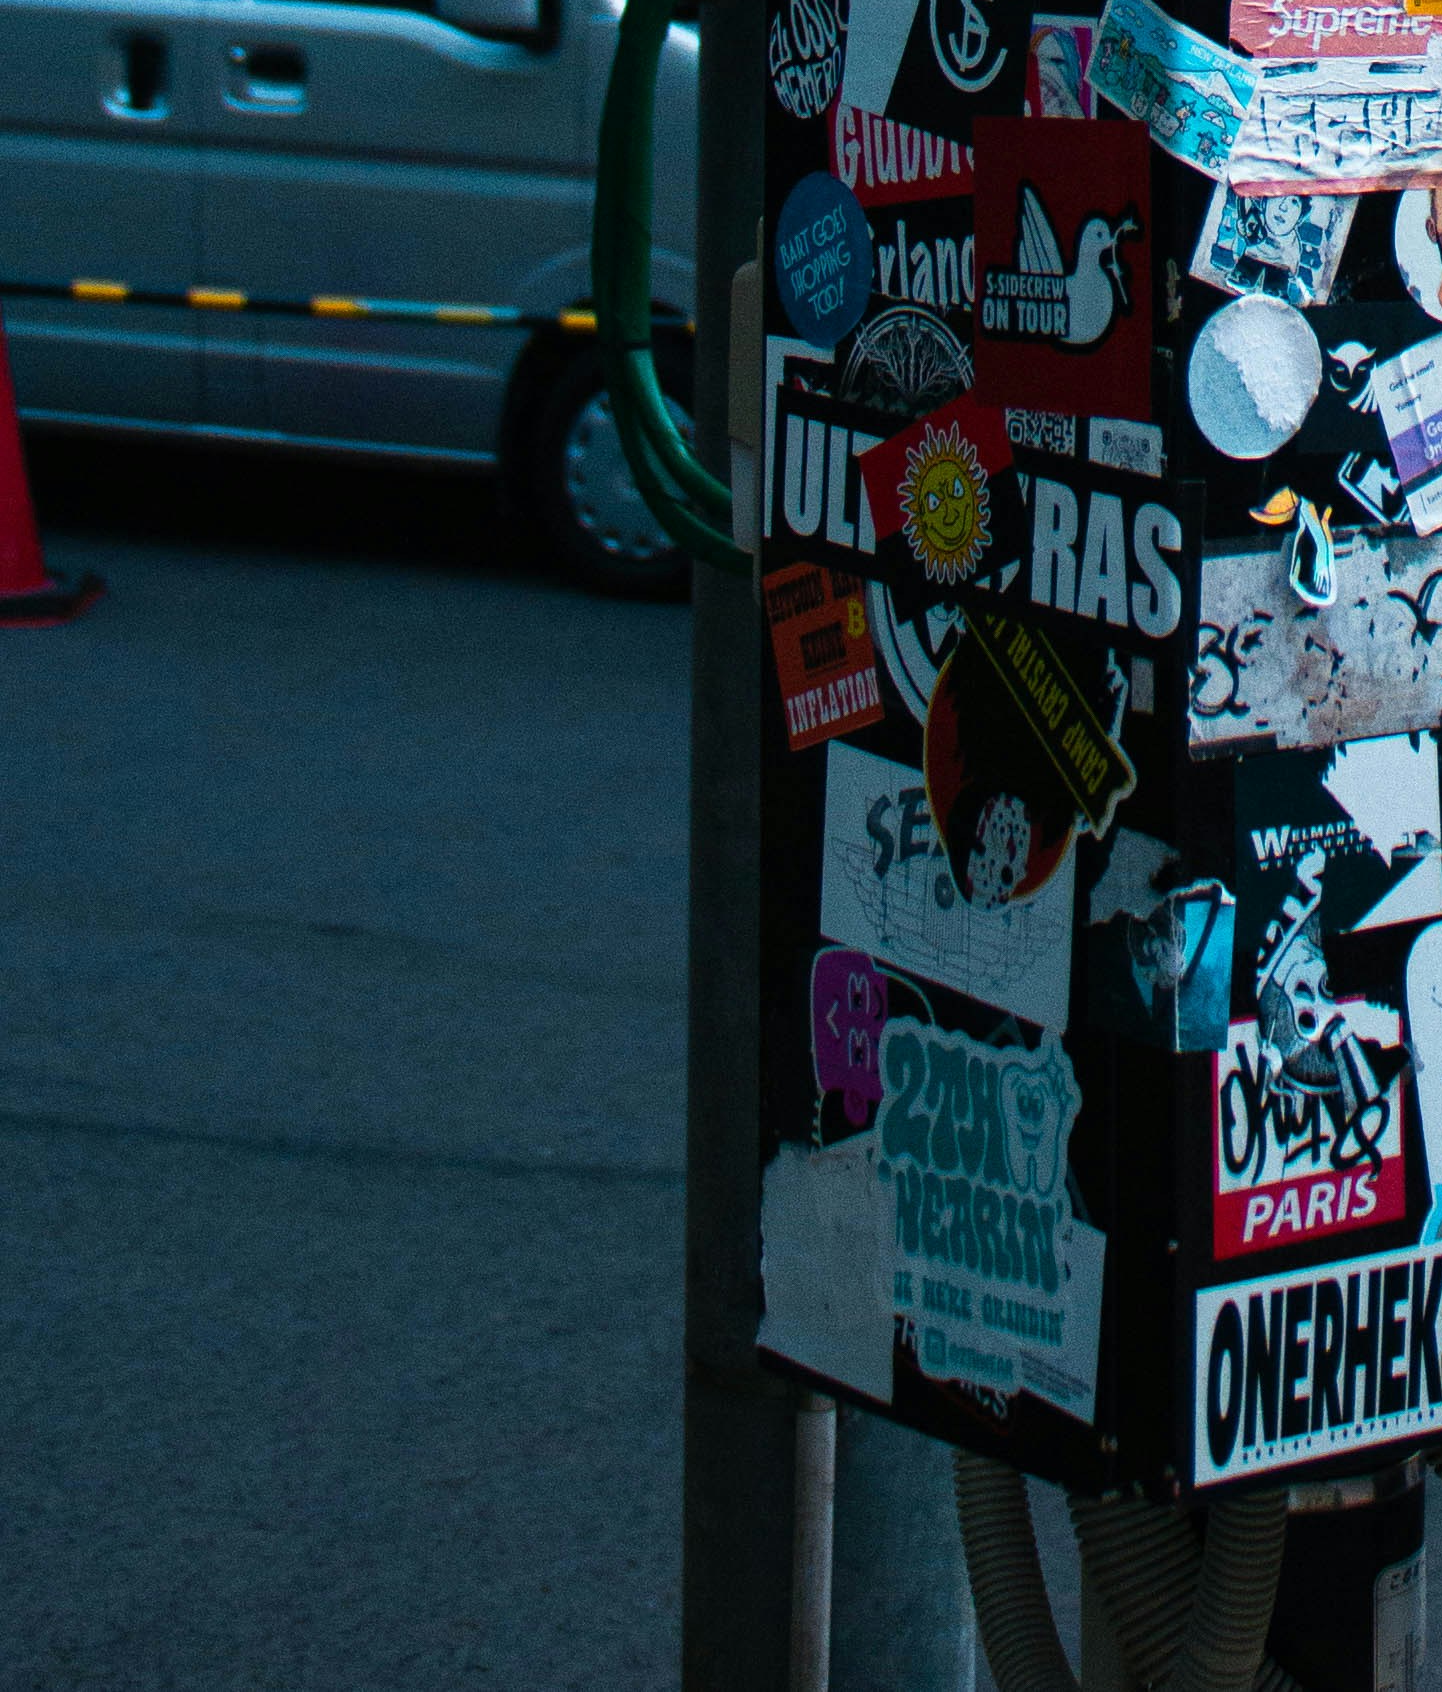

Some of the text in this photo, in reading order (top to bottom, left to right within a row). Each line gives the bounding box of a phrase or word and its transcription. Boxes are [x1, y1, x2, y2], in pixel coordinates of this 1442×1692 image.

[789, 242, 852, 300] SHOPPING
[805, 281, 847, 321] TOO!
[981, 300, 1067, 337] ON TOUR
[785, 665, 881, 736] INFLATION
[1242, 1177, 1378, 1245] PARIS
